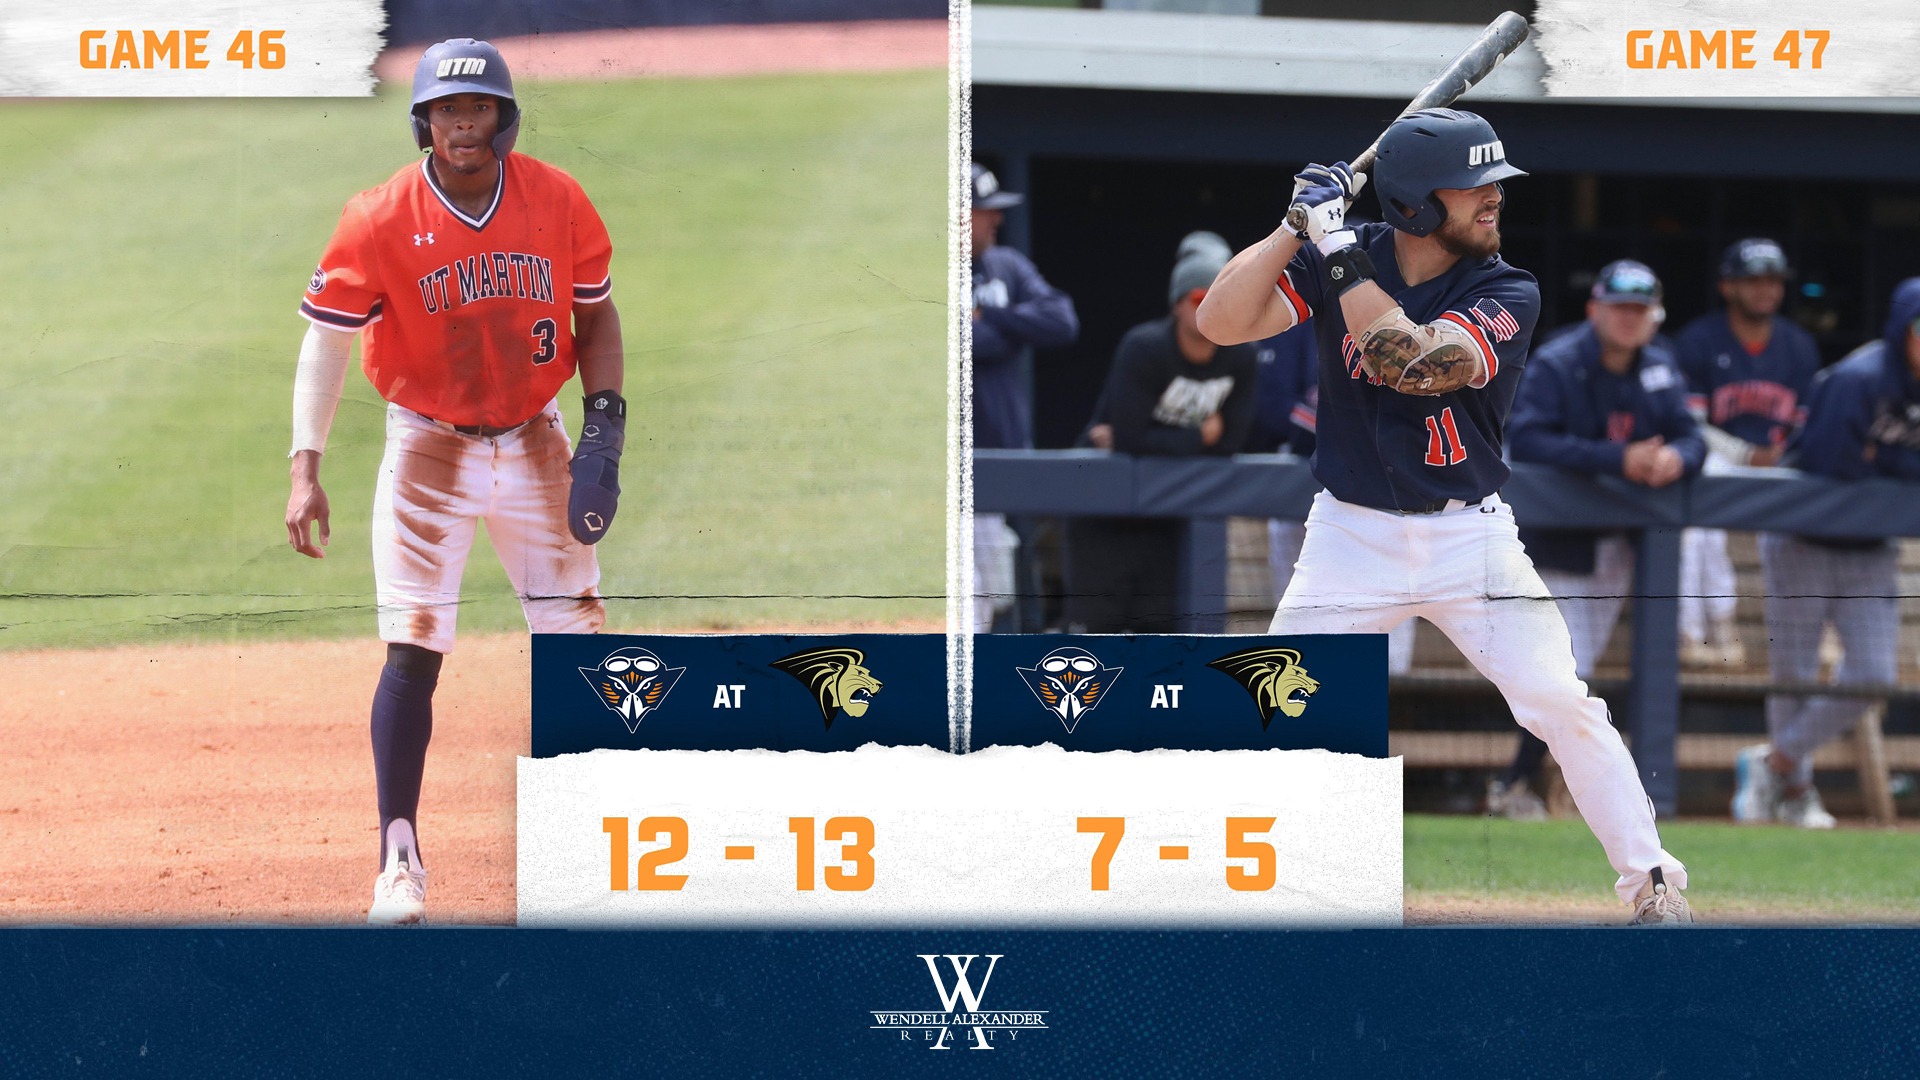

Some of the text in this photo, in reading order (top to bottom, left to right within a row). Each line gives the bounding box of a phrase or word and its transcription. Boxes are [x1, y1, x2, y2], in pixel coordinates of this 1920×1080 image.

[436, 57, 487, 78] UTM
[418, 252, 555, 315] UT MARTIN
[531, 317, 557, 367] 3
[1424, 406, 1468, 467] 11
